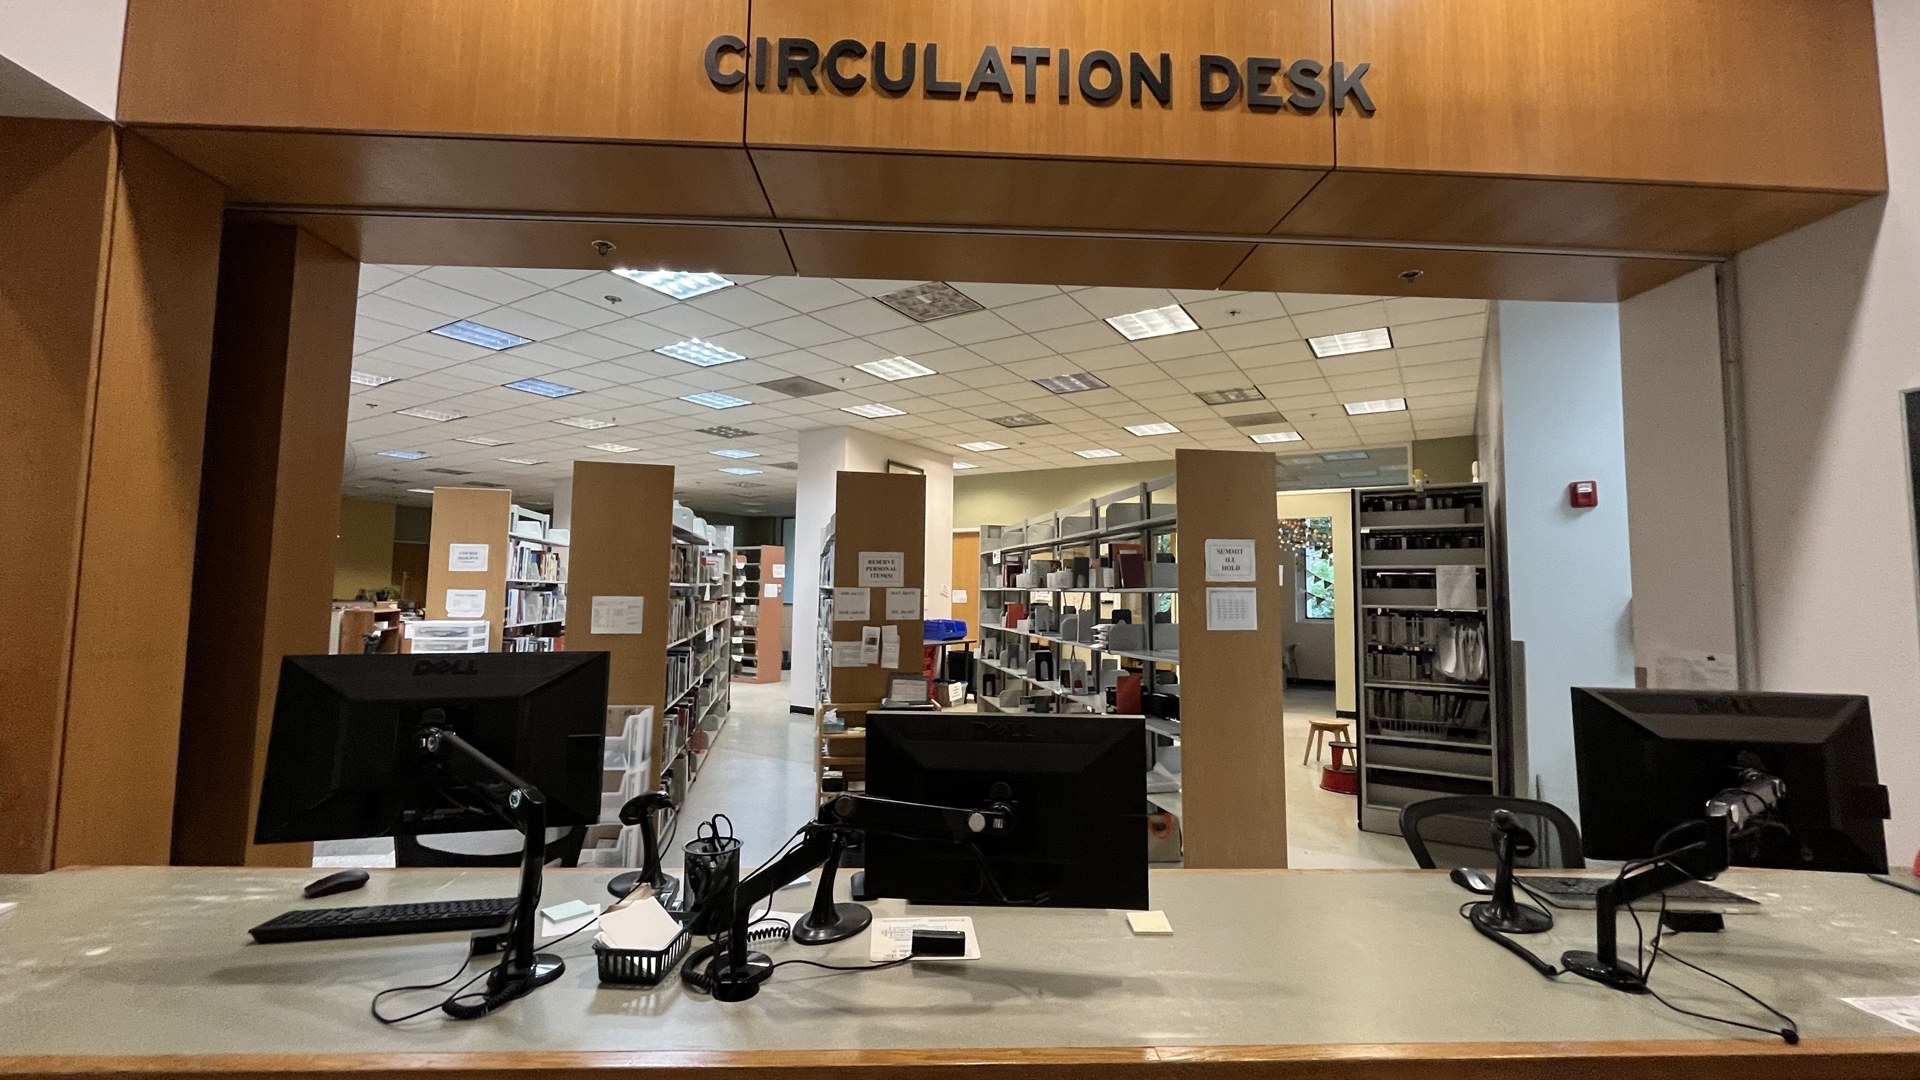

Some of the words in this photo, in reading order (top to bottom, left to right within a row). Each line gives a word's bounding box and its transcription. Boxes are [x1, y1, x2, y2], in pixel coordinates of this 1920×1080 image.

[704, 35, 1172, 106] CIRCULATION
[1200, 54, 1377, 114] DESK
[412, 660, 478, 676] DELL
